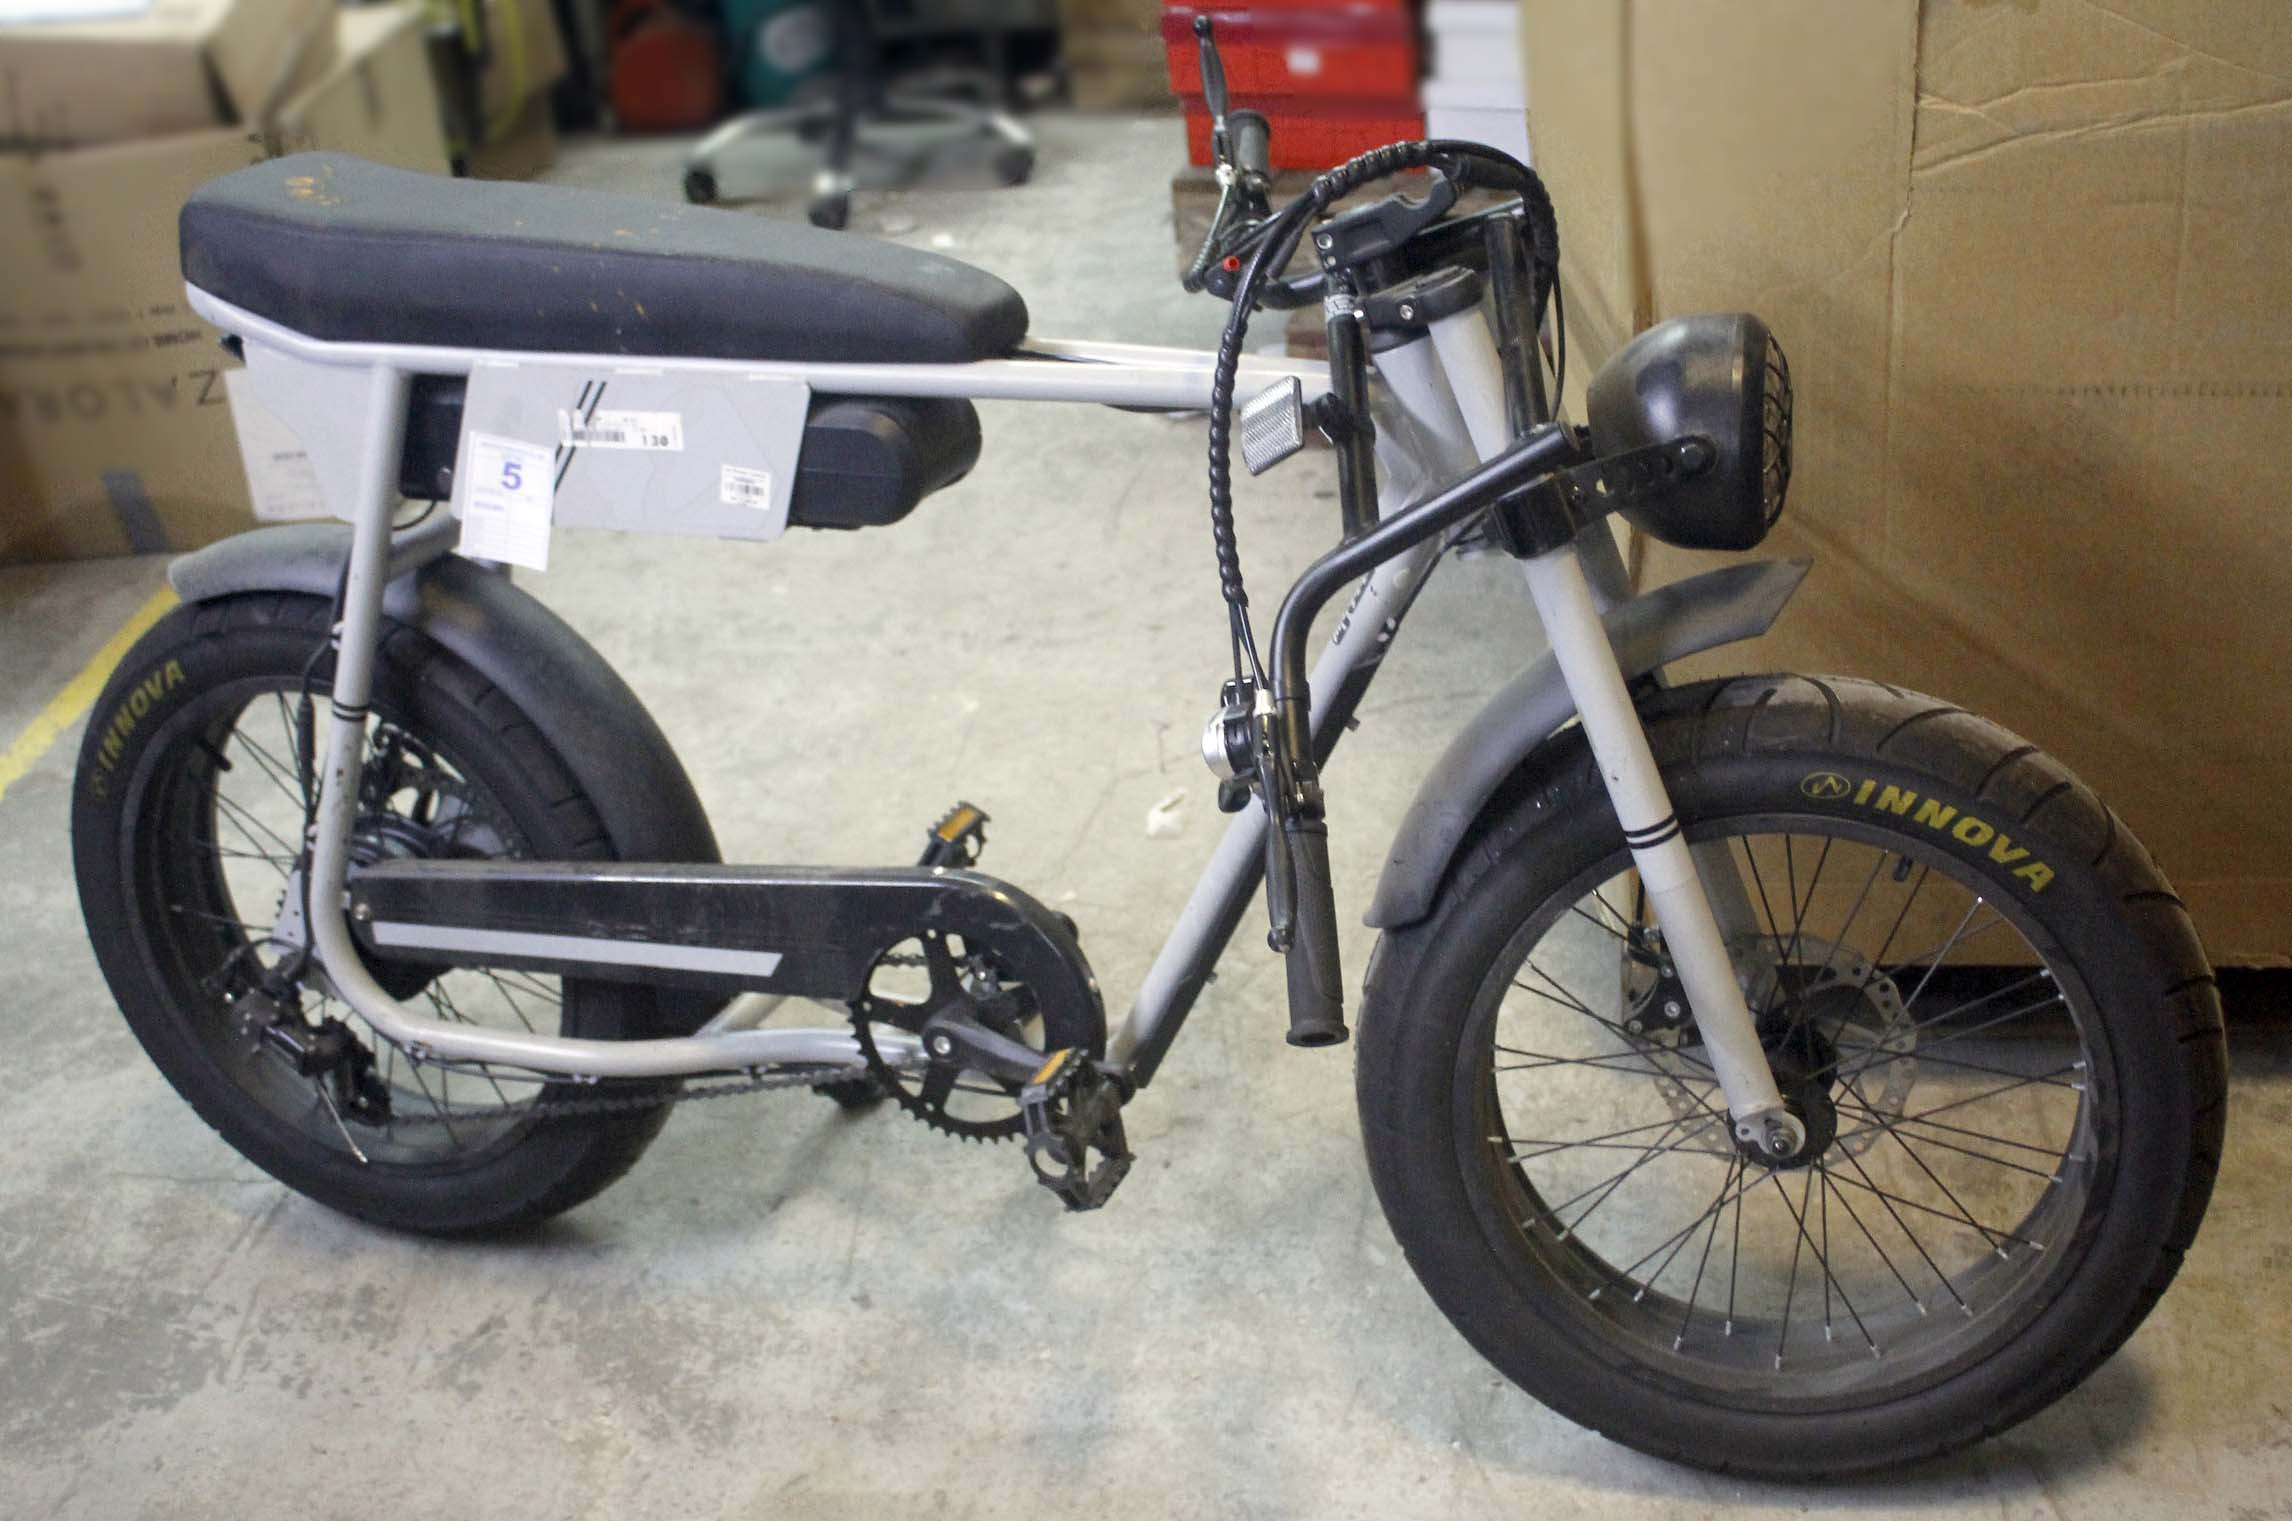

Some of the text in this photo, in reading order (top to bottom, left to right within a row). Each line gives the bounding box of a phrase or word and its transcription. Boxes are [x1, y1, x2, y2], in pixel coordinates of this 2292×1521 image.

[502, 461, 523, 490] 5
[98, 659, 185, 770] INNOVA
[1853, 778, 2055, 894] INNOVA
